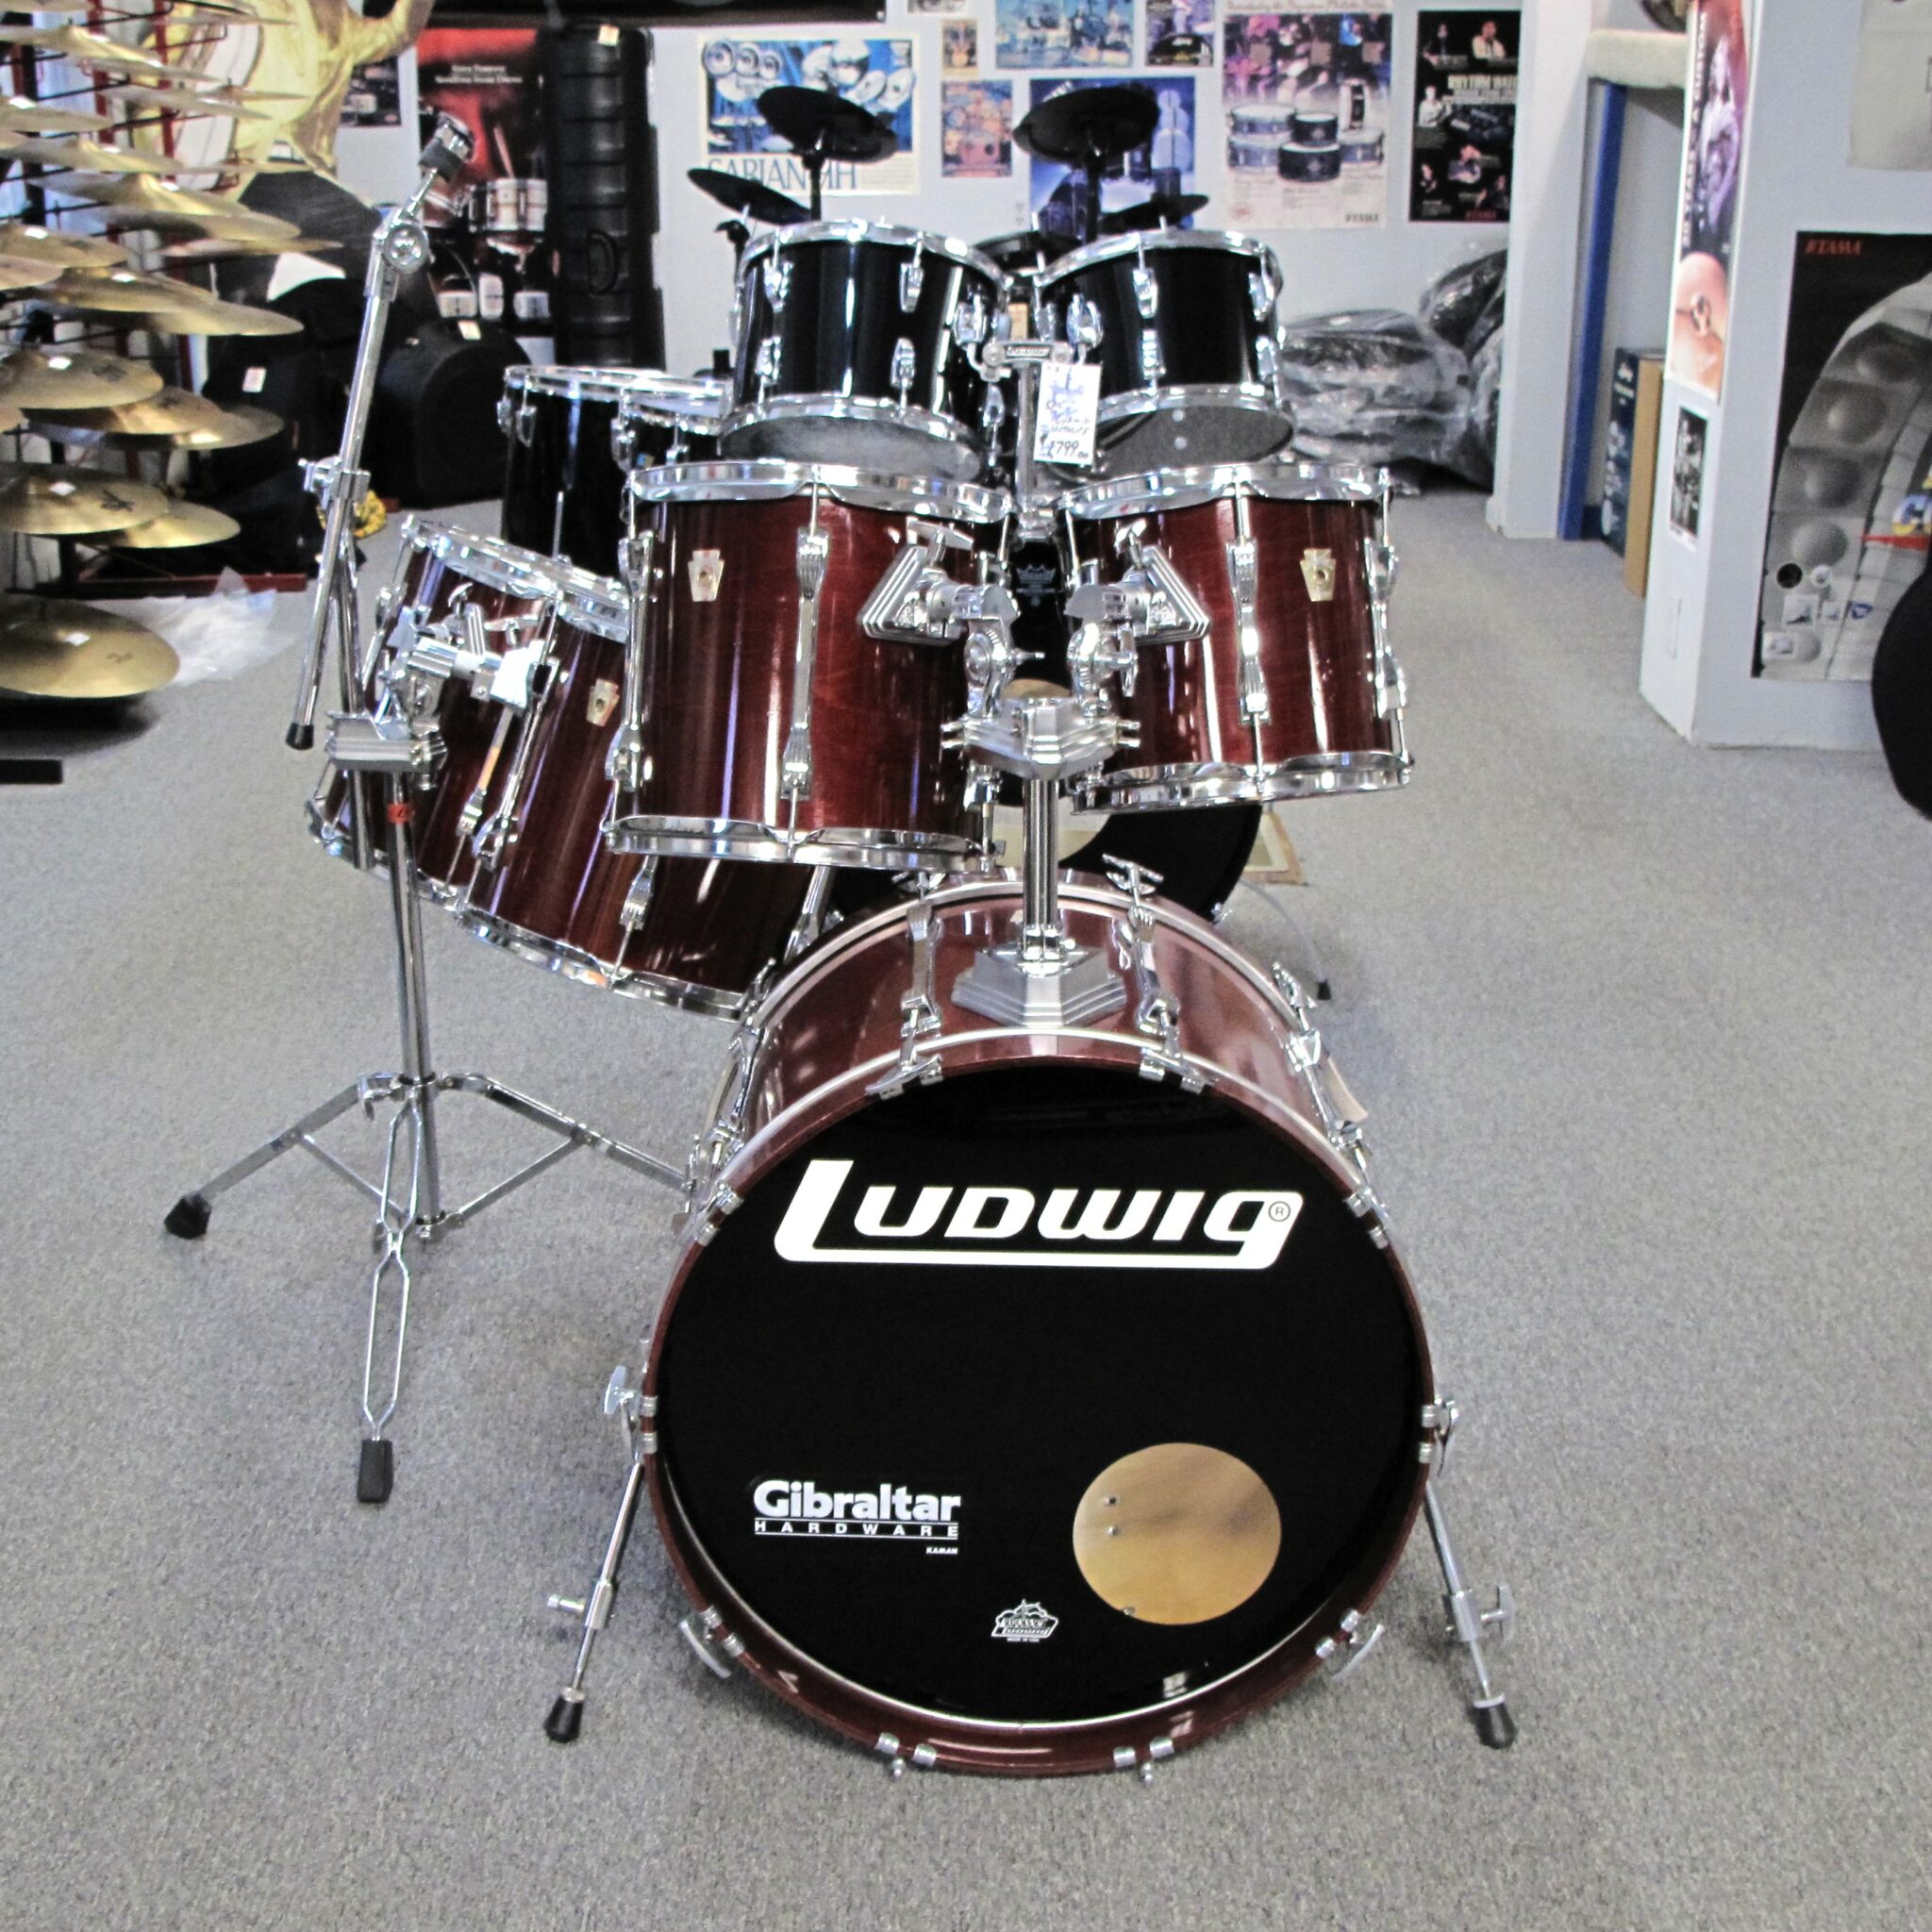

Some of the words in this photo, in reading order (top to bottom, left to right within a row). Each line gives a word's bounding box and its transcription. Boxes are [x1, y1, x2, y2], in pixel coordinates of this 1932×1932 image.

[754, 1480, 960, 1522] Gibraltar
[755, 1520, 958, 1538] HARDWARE
[925, 1547, 958, 1556] KAMAN
